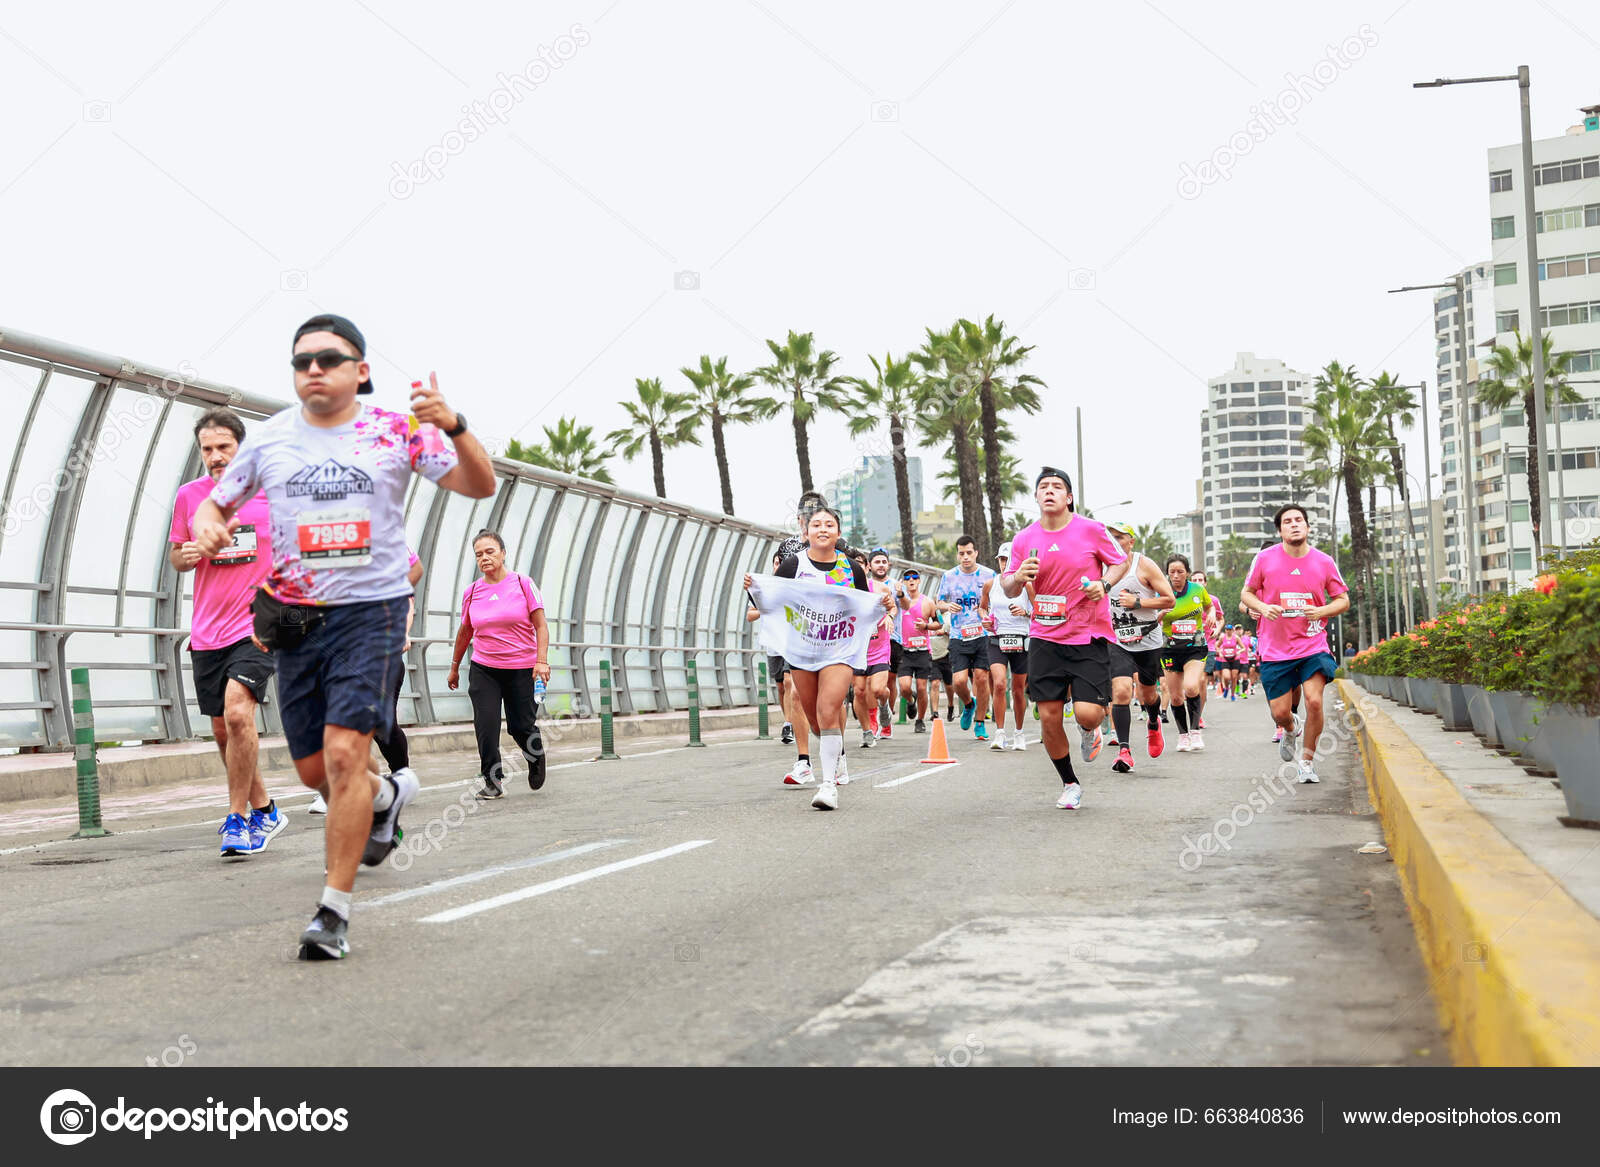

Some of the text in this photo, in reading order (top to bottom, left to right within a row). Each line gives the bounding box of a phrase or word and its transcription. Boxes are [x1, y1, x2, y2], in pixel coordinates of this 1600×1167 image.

[287, 480, 373, 497] INDEPENDENCIA
[308, 523, 359, 545] 7956
[800, 605, 843, 623] REBELDES
[1118, 628, 1136, 637] 1638
